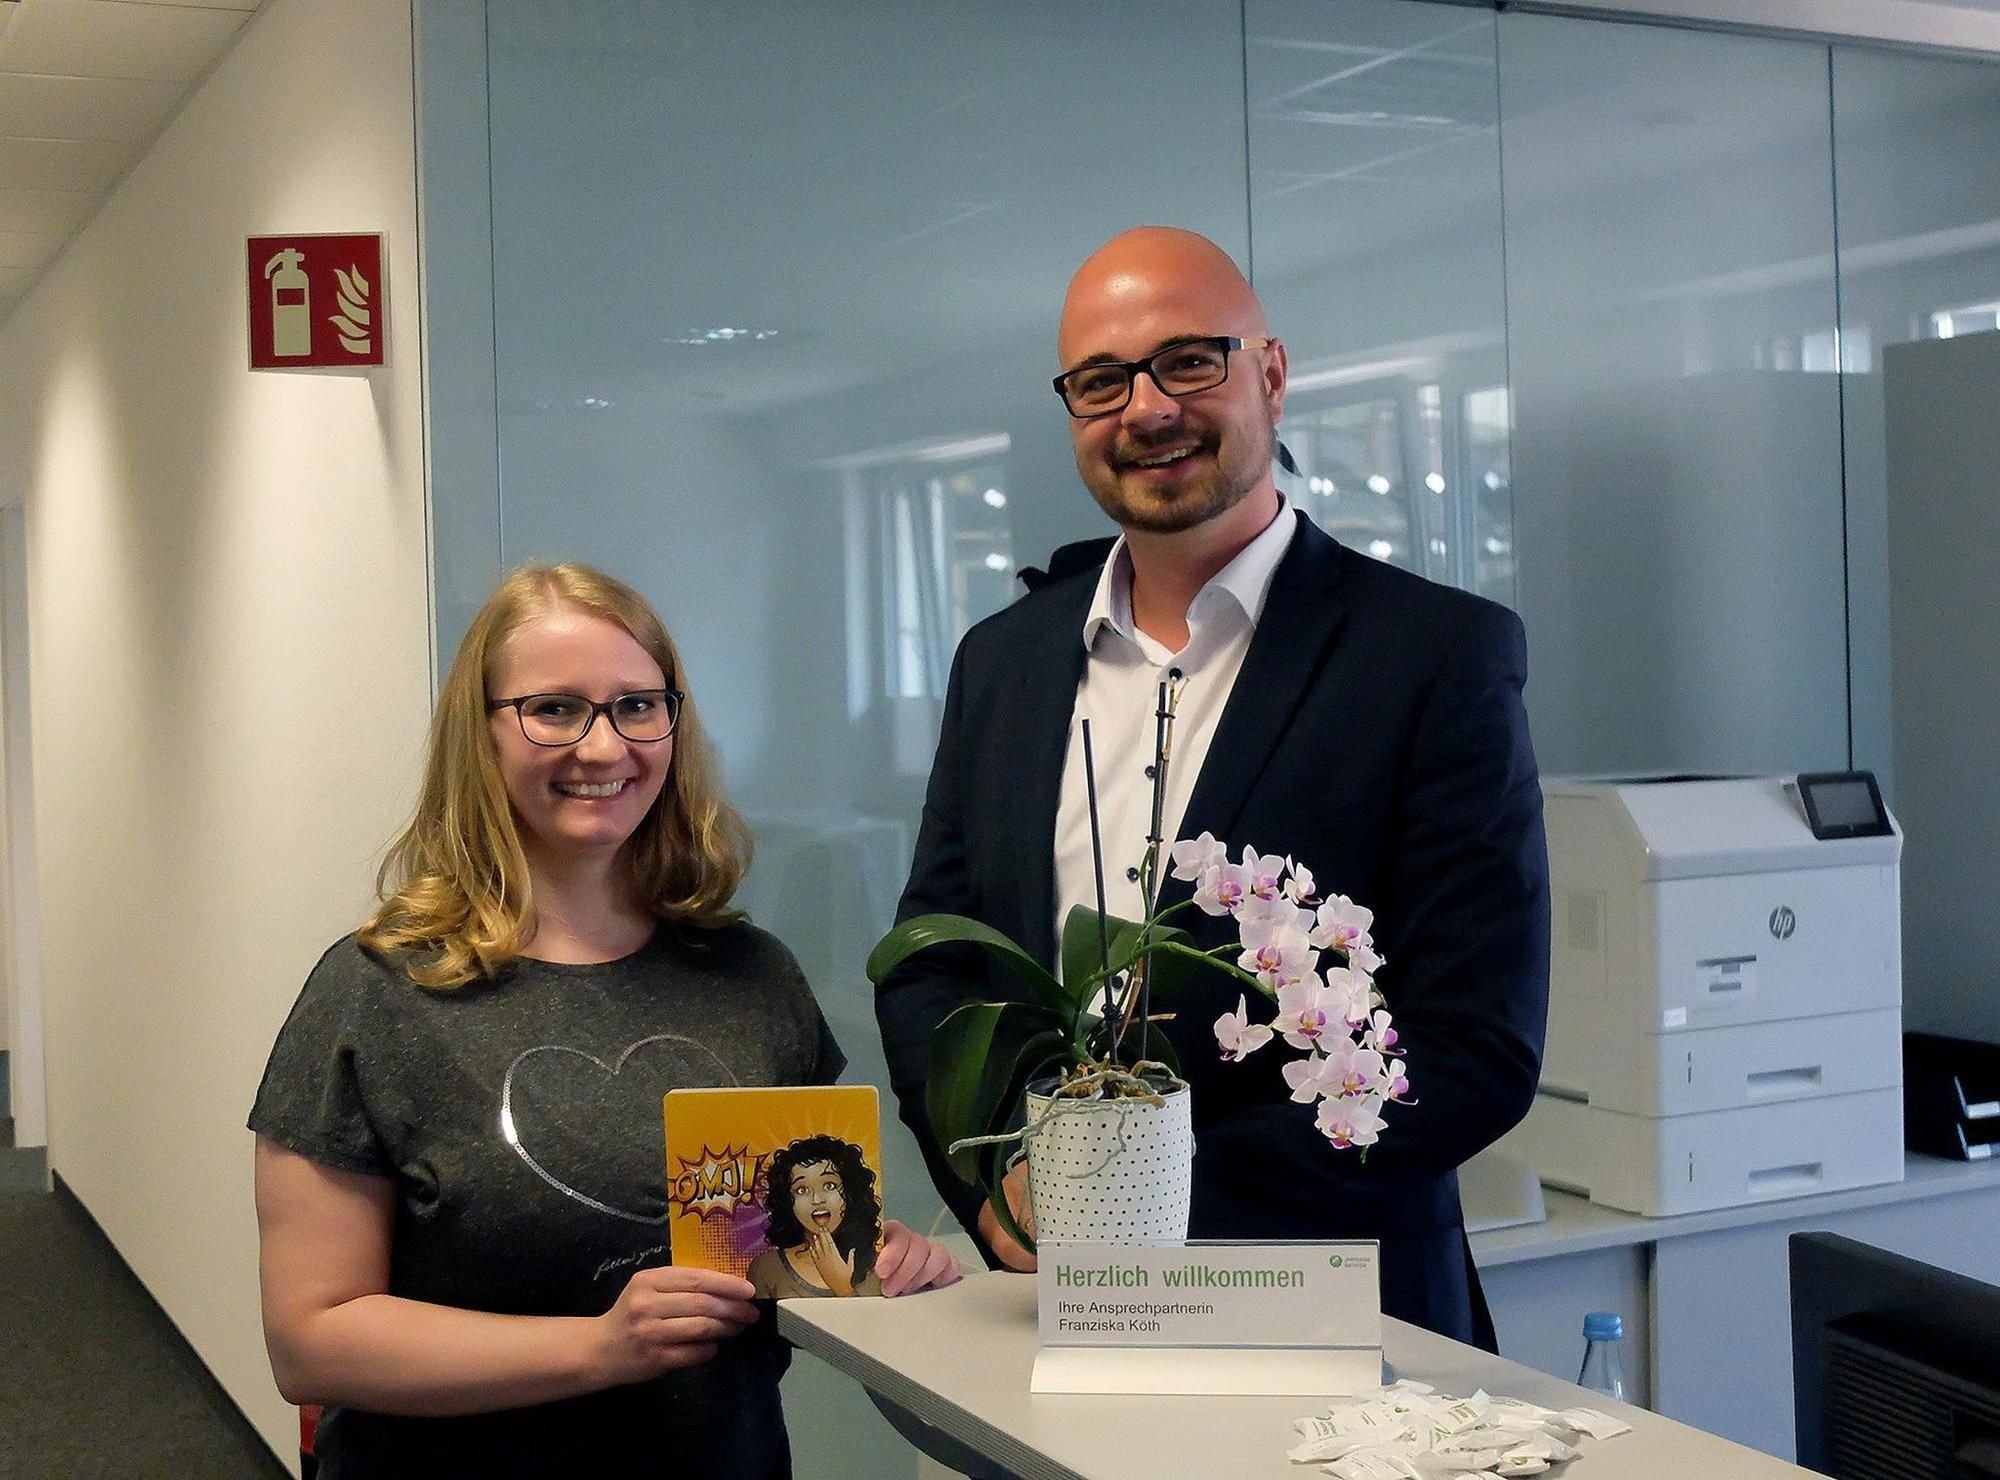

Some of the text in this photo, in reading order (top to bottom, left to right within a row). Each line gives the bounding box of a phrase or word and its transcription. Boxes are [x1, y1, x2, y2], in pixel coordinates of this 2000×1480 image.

[1056, 1265, 1305, 1288] Herzlich willkommen
[1058, 1301, 1214, 1317] Ihre Ansprechpartnerin
[1059, 1318, 1161, 1332] Franziska Köth
